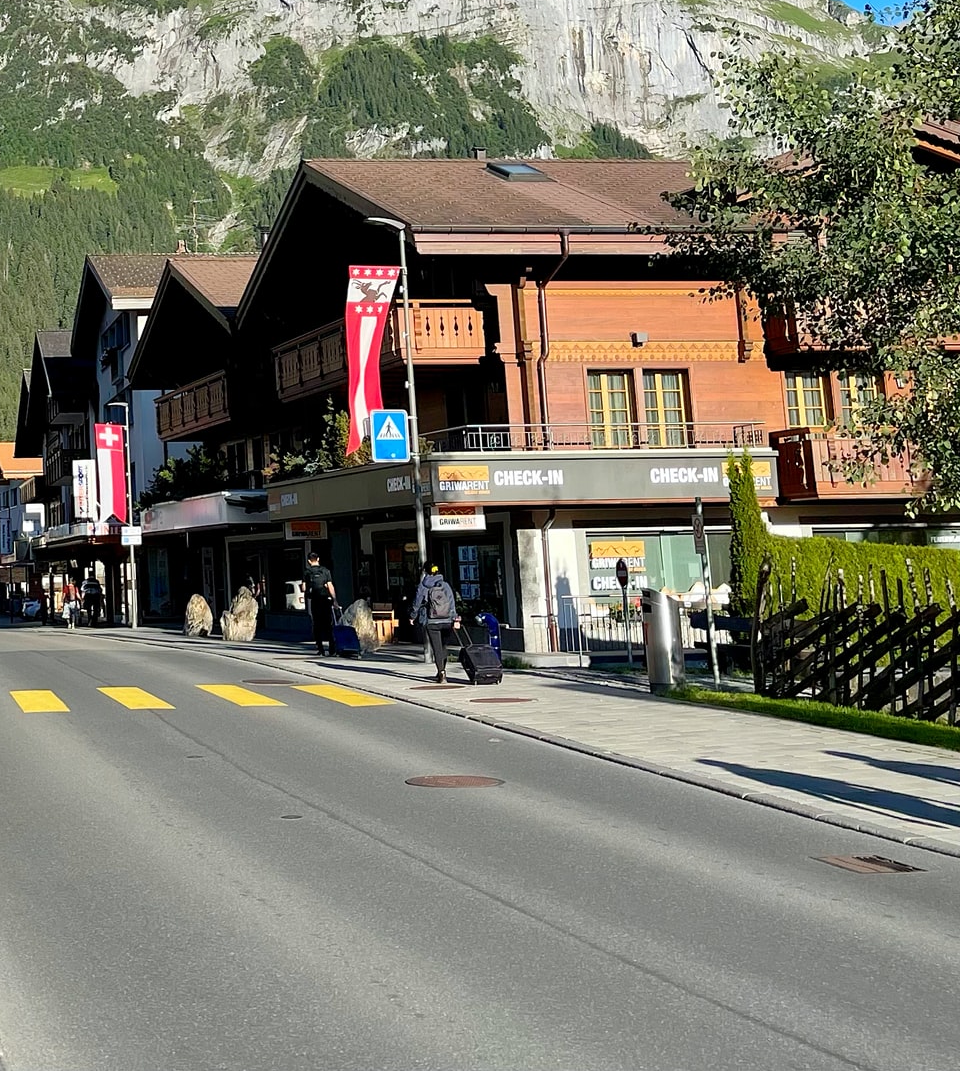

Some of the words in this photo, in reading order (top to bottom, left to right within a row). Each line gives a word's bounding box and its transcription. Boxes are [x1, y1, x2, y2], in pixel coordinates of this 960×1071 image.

[493, 469, 564, 486] CHECK-IN
[650, 467, 719, 484] CHECK-IN
[439, 481, 490, 491] GRIWARENT
[439, 517, 476, 526] GRIWARENT
[591, 557, 645, 569] GRIWRENT
[593, 575, 648, 589] CHE-IN
